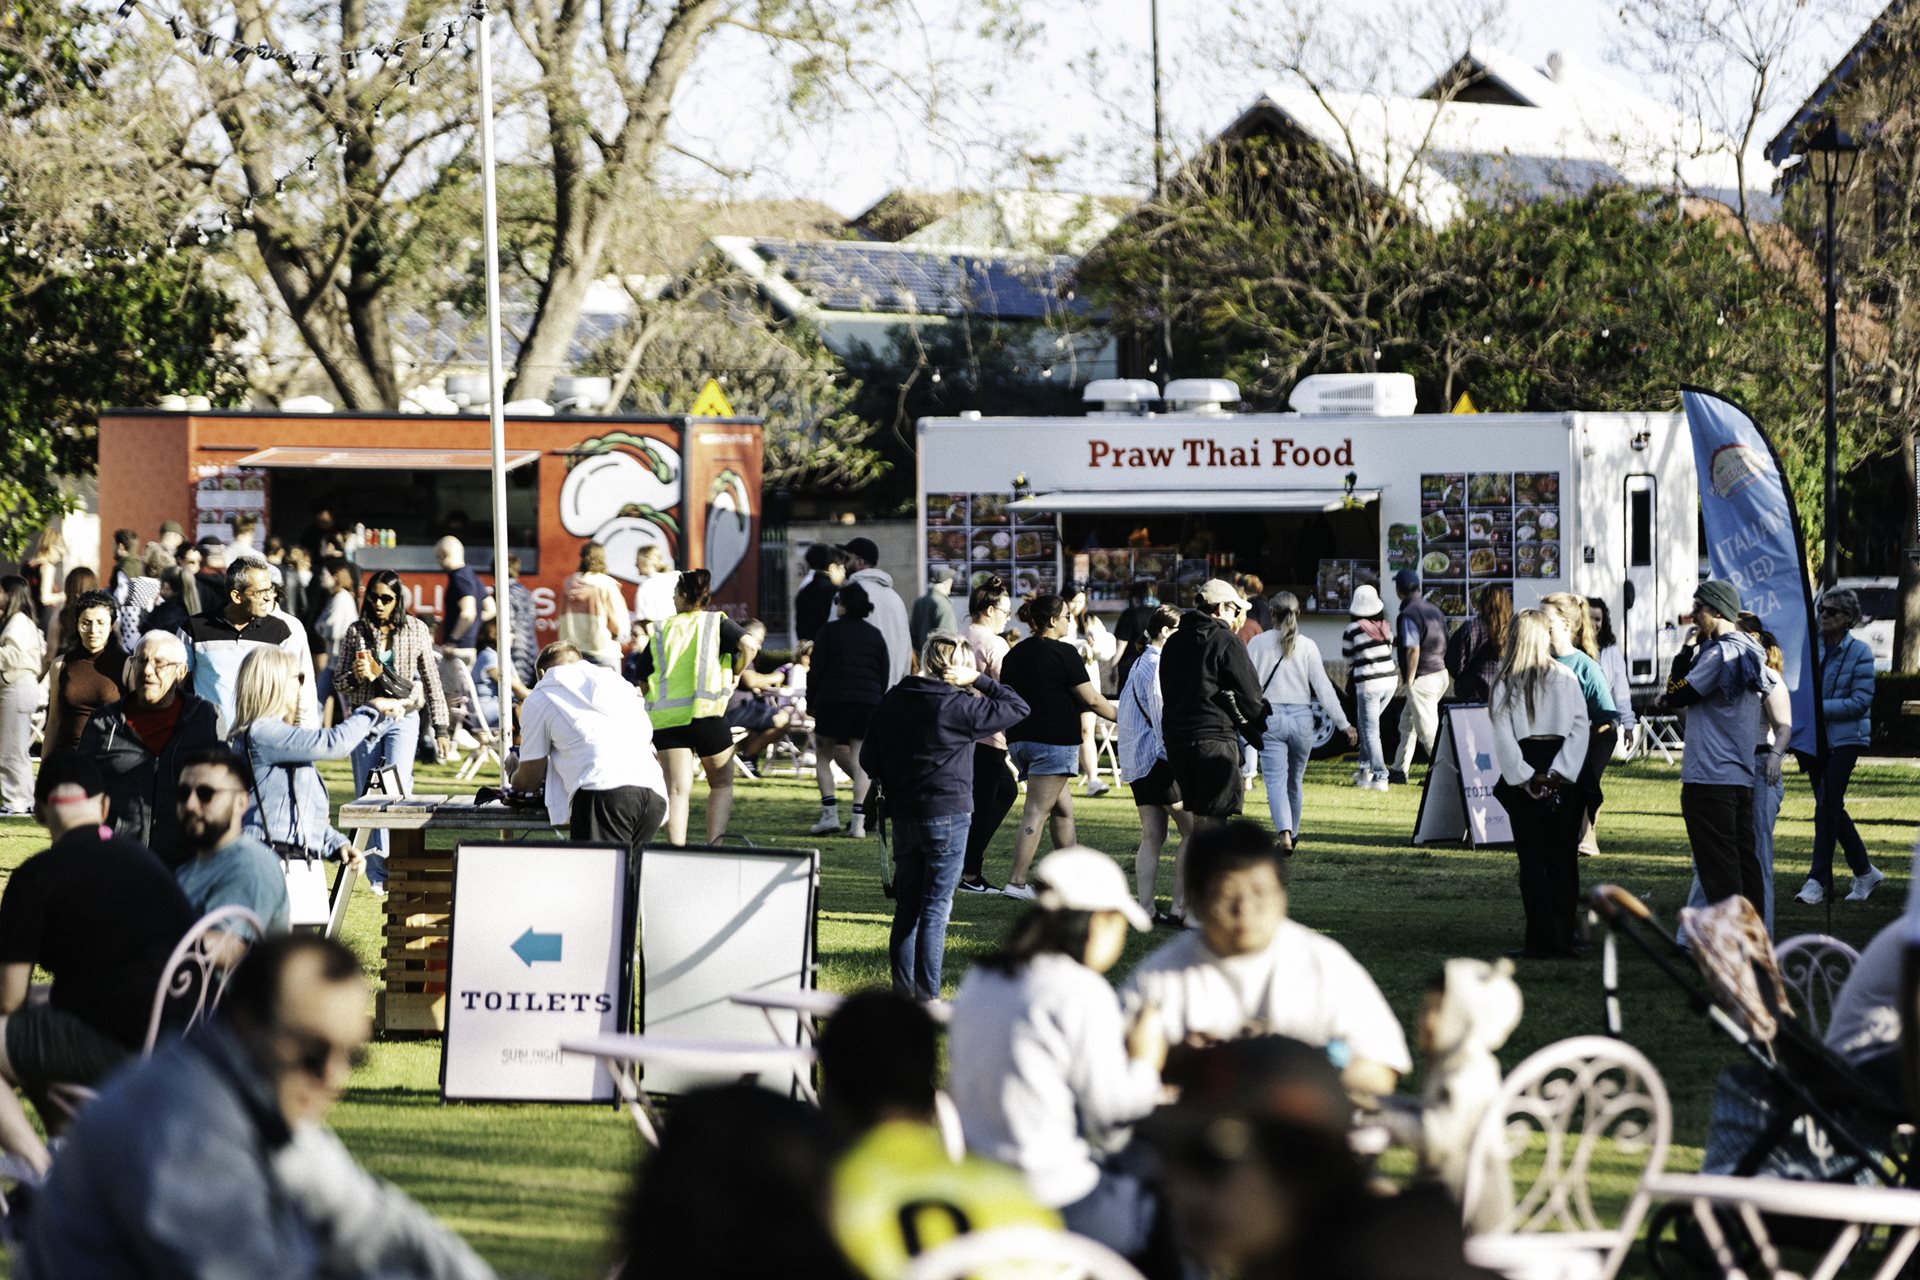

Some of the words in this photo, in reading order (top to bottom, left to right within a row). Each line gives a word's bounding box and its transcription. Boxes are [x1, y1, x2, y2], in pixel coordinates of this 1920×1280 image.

[1088, 439, 1175, 468] Praw
[1182, 438, 1261, 467] Thai
[1272, 438, 1355, 467] Food
[1715, 506, 1786, 566] ITALIAN
[1728, 555, 1776, 592] RIED
[1744, 590, 1782, 618] ZZA
[1465, 785, 1495, 798] TOIL
[461, 990, 612, 1013] TOILETS
